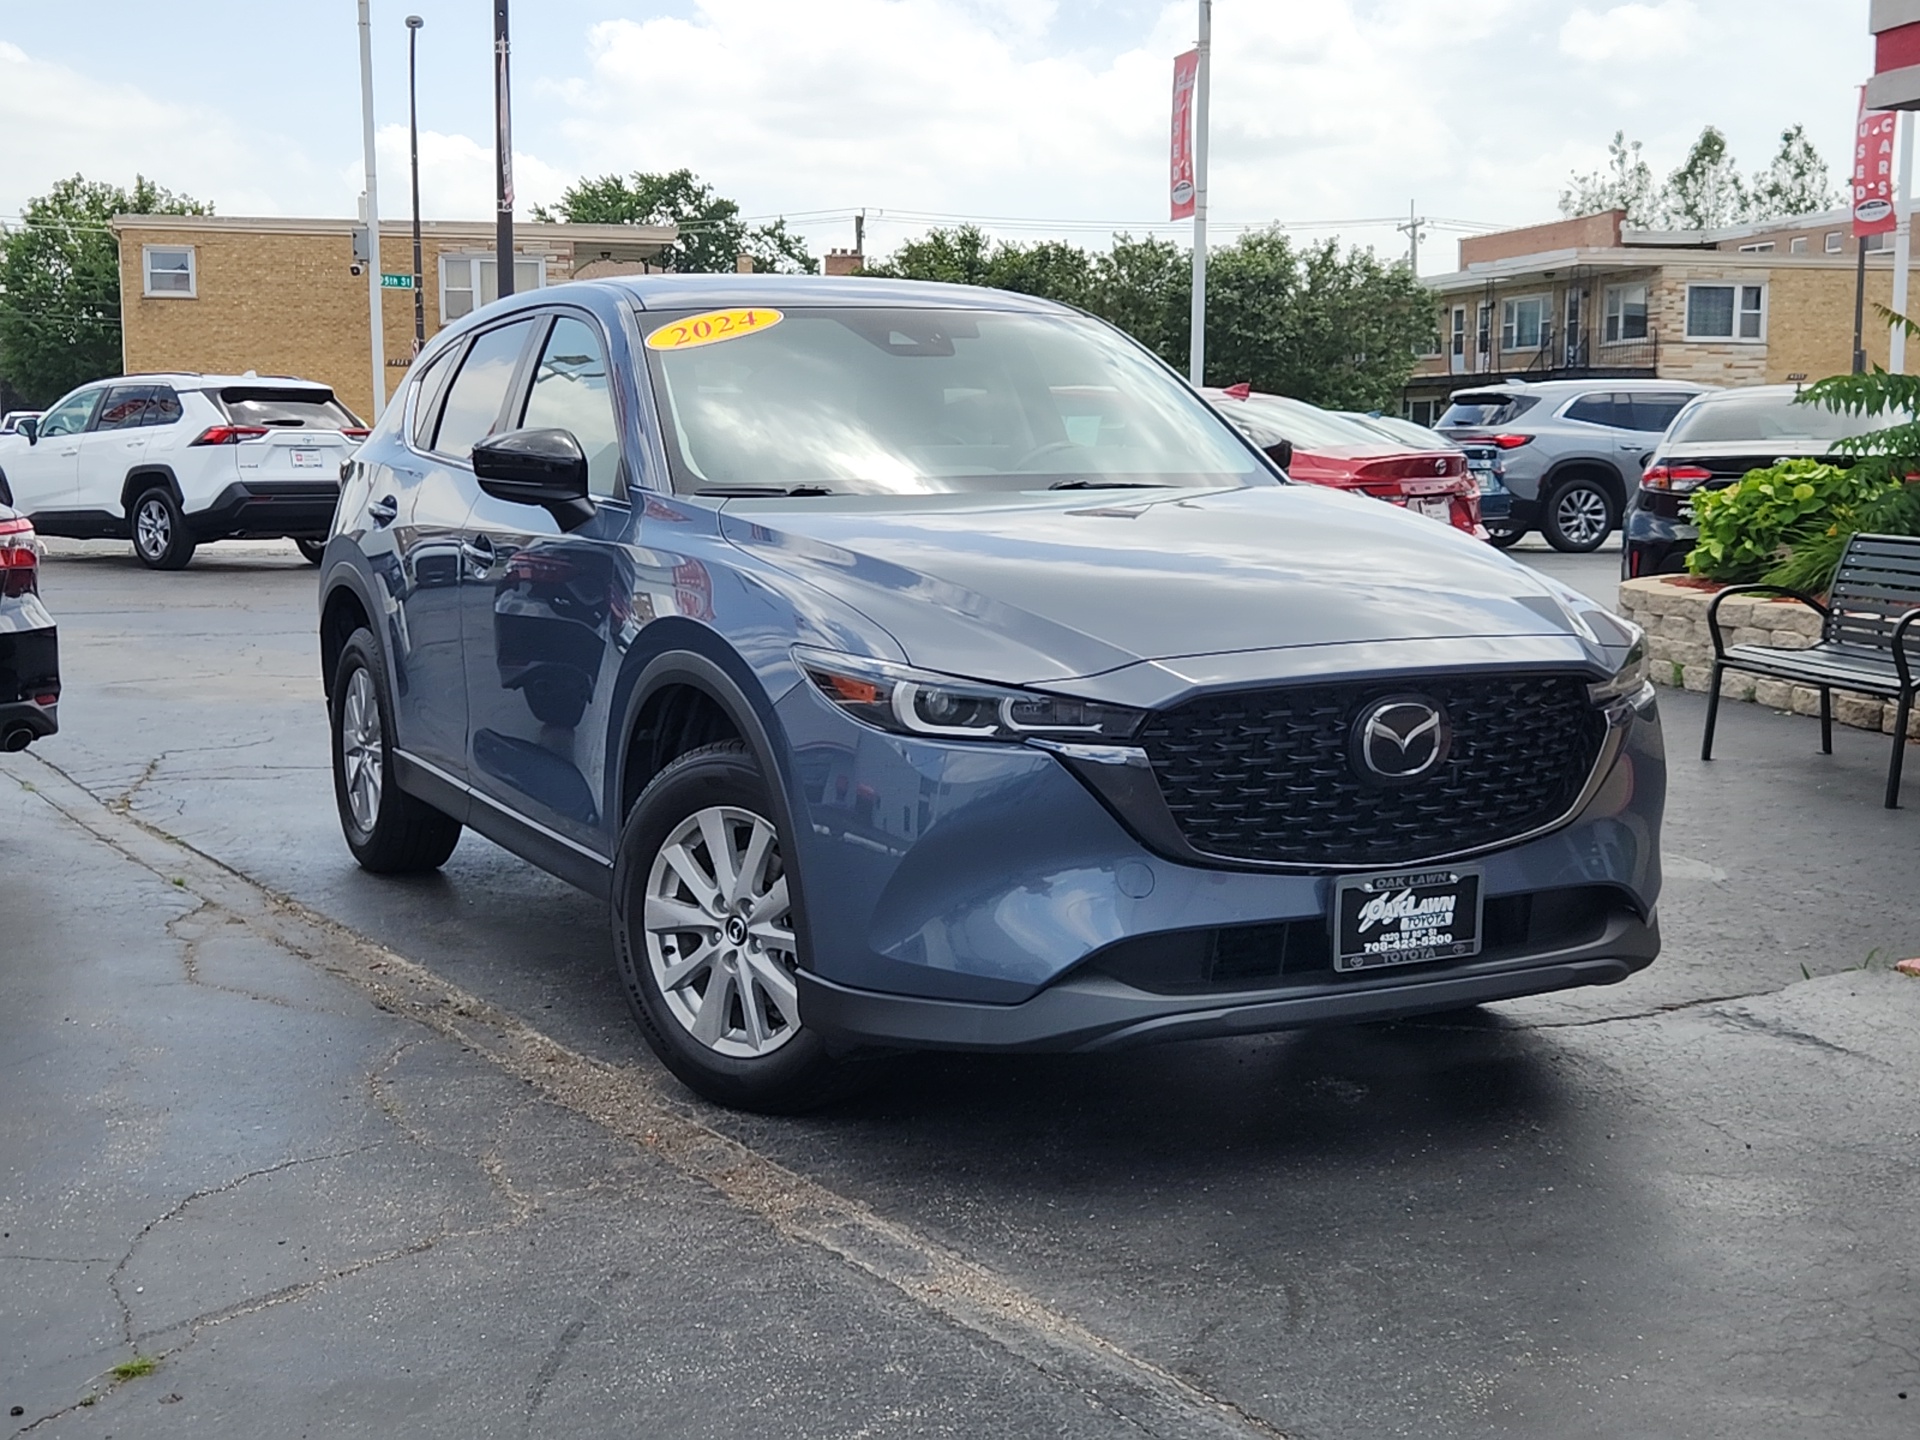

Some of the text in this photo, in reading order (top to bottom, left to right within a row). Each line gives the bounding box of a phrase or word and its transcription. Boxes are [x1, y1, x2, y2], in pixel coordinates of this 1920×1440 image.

[1855, 122, 1869, 200] USED
[1878, 118, 1893, 197] CARS
[401, 276, 410, 286] St
[670, 310, 758, 346] 2024
[1375, 872, 1448, 889] OAK LAWN
[1407, 914, 1447, 929] TOYOTA
[1401, 930, 1410, 939] W
[1364, 933, 1453, 954] 708-423-5200
[1381, 947, 1437, 964] TOYOTA
